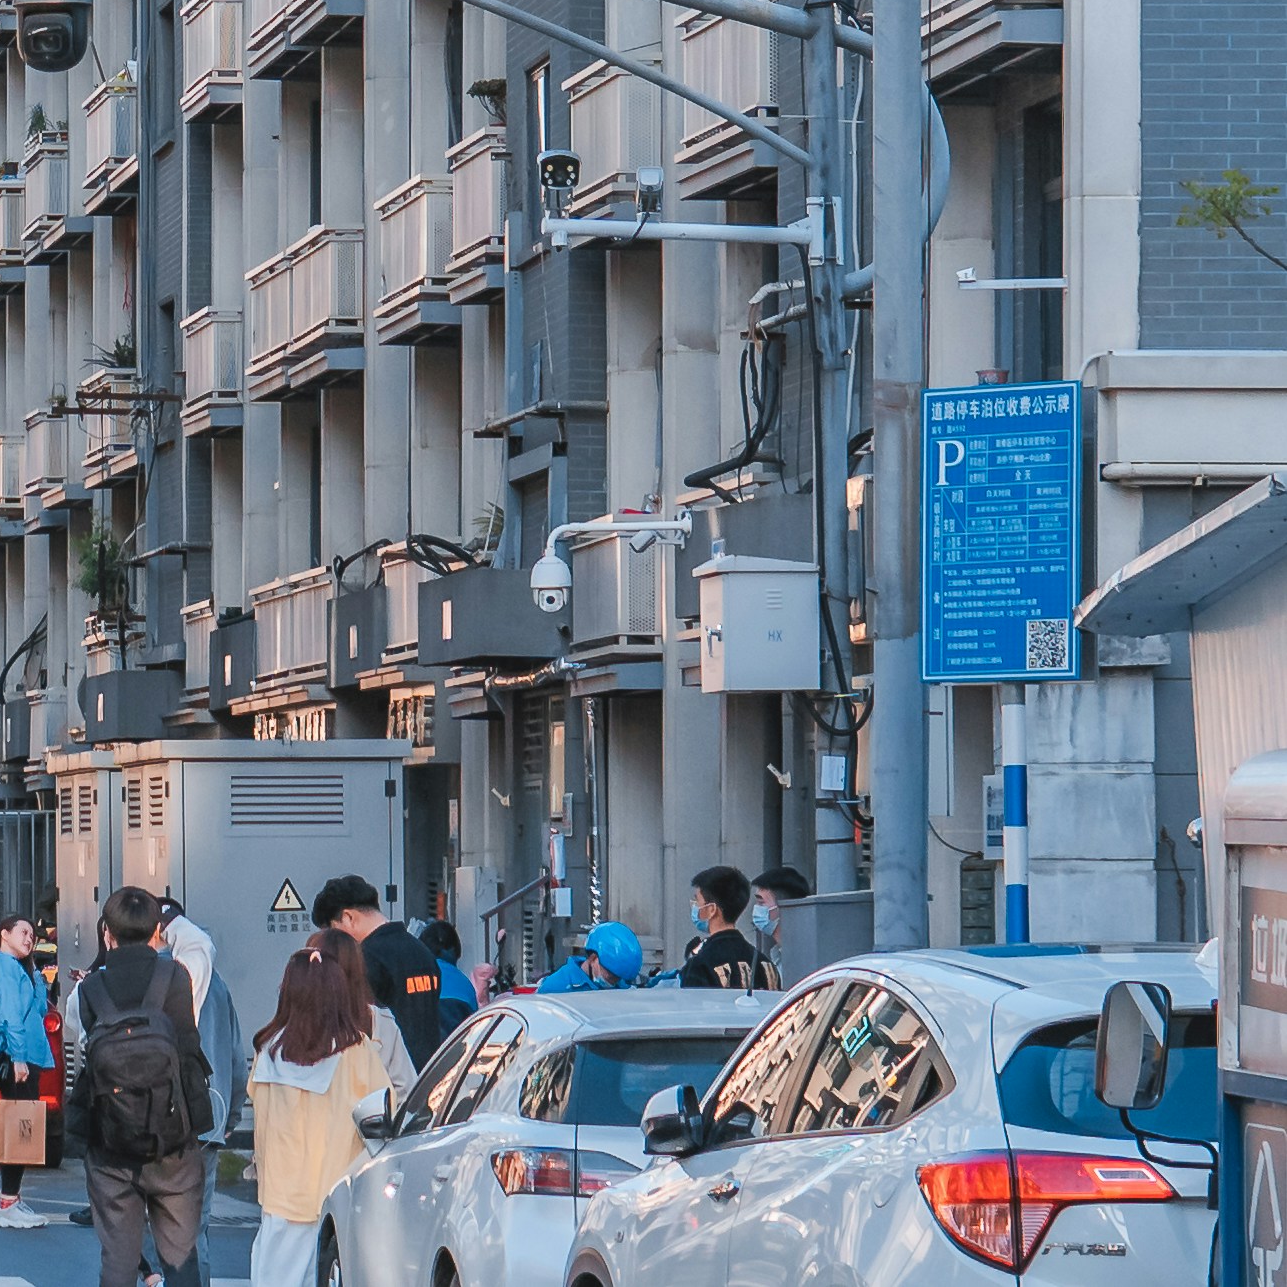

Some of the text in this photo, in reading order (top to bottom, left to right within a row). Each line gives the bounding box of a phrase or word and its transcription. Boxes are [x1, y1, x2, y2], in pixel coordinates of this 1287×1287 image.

[931, 393, 1070, 422] 道路停车泊位收费公示牌
[935, 440, 965, 486] P
[768, 629, 783, 642] HX
